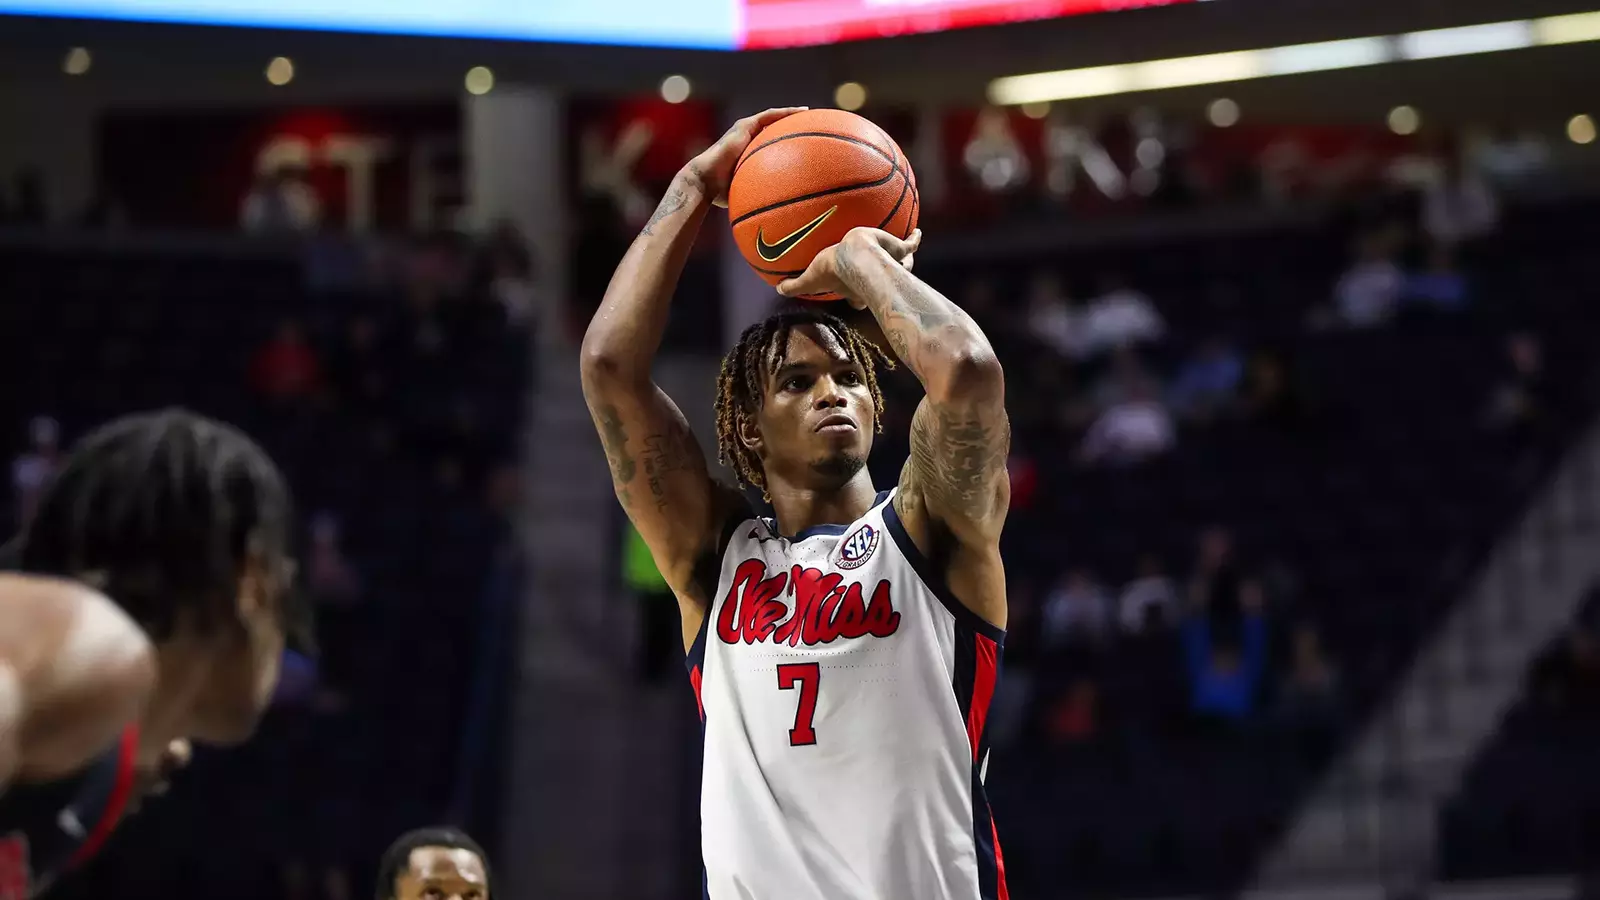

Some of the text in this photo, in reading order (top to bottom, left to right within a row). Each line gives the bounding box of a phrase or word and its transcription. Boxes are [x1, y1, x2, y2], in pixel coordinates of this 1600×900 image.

[844, 526, 873, 559] SEC
[717, 558, 901, 647] Ole Miss
[776, 662, 820, 746] 7
